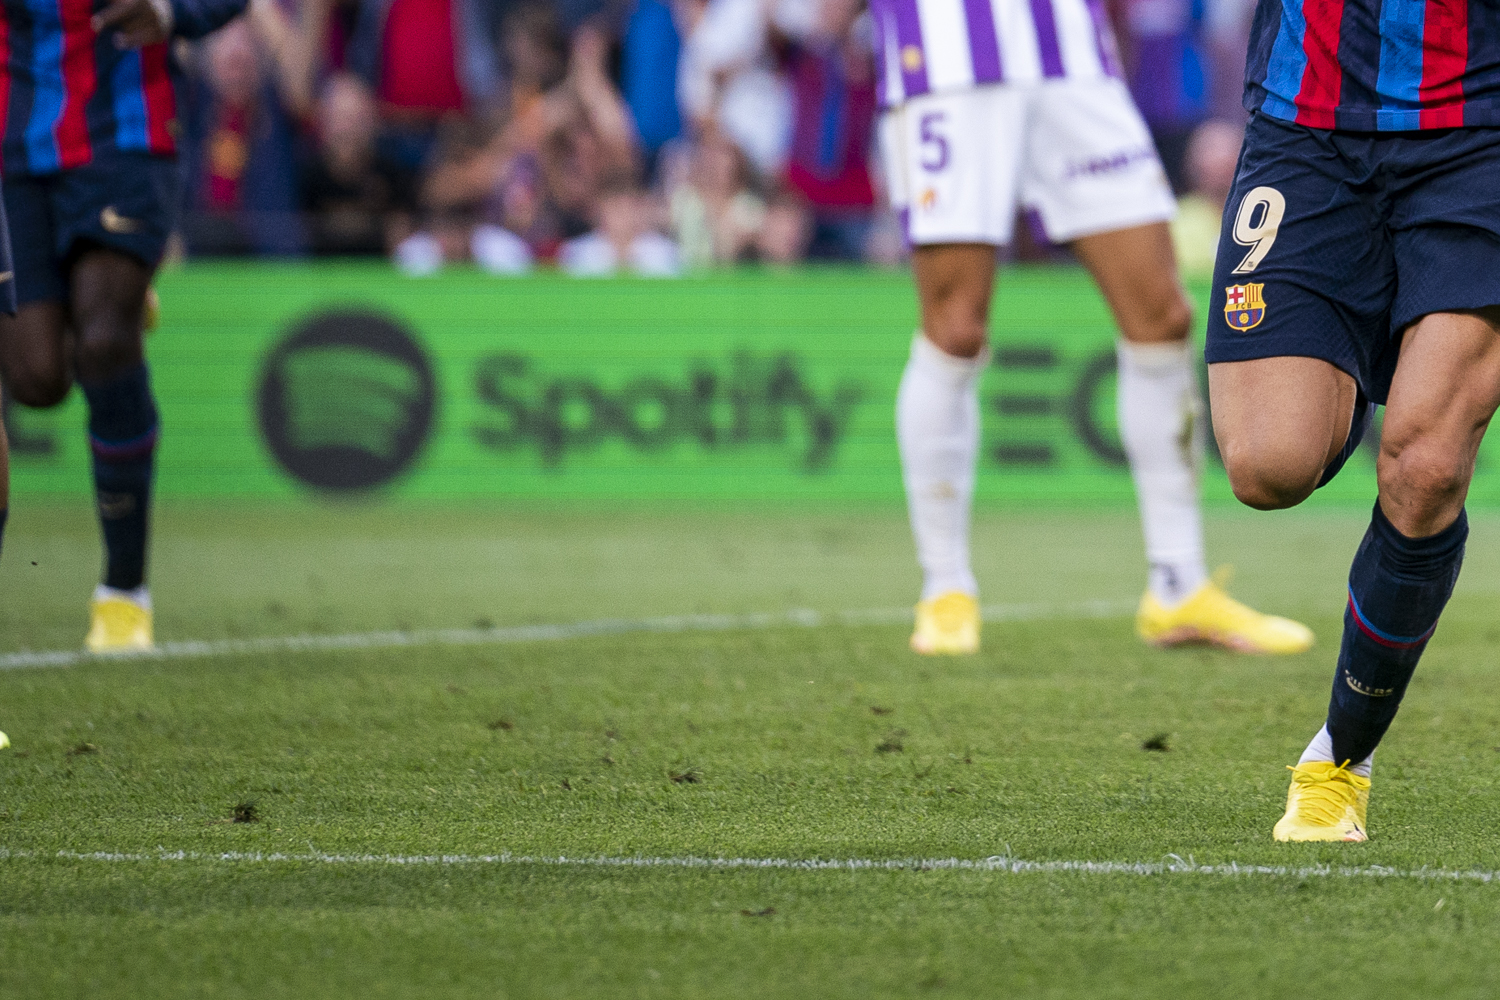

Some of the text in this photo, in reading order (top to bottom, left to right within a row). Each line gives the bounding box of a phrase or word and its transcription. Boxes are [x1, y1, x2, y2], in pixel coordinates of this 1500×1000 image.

[919, 110, 950, 174] 5
[1231, 186, 1286, 274] 9
[472, 348, 868, 474] Spotify
